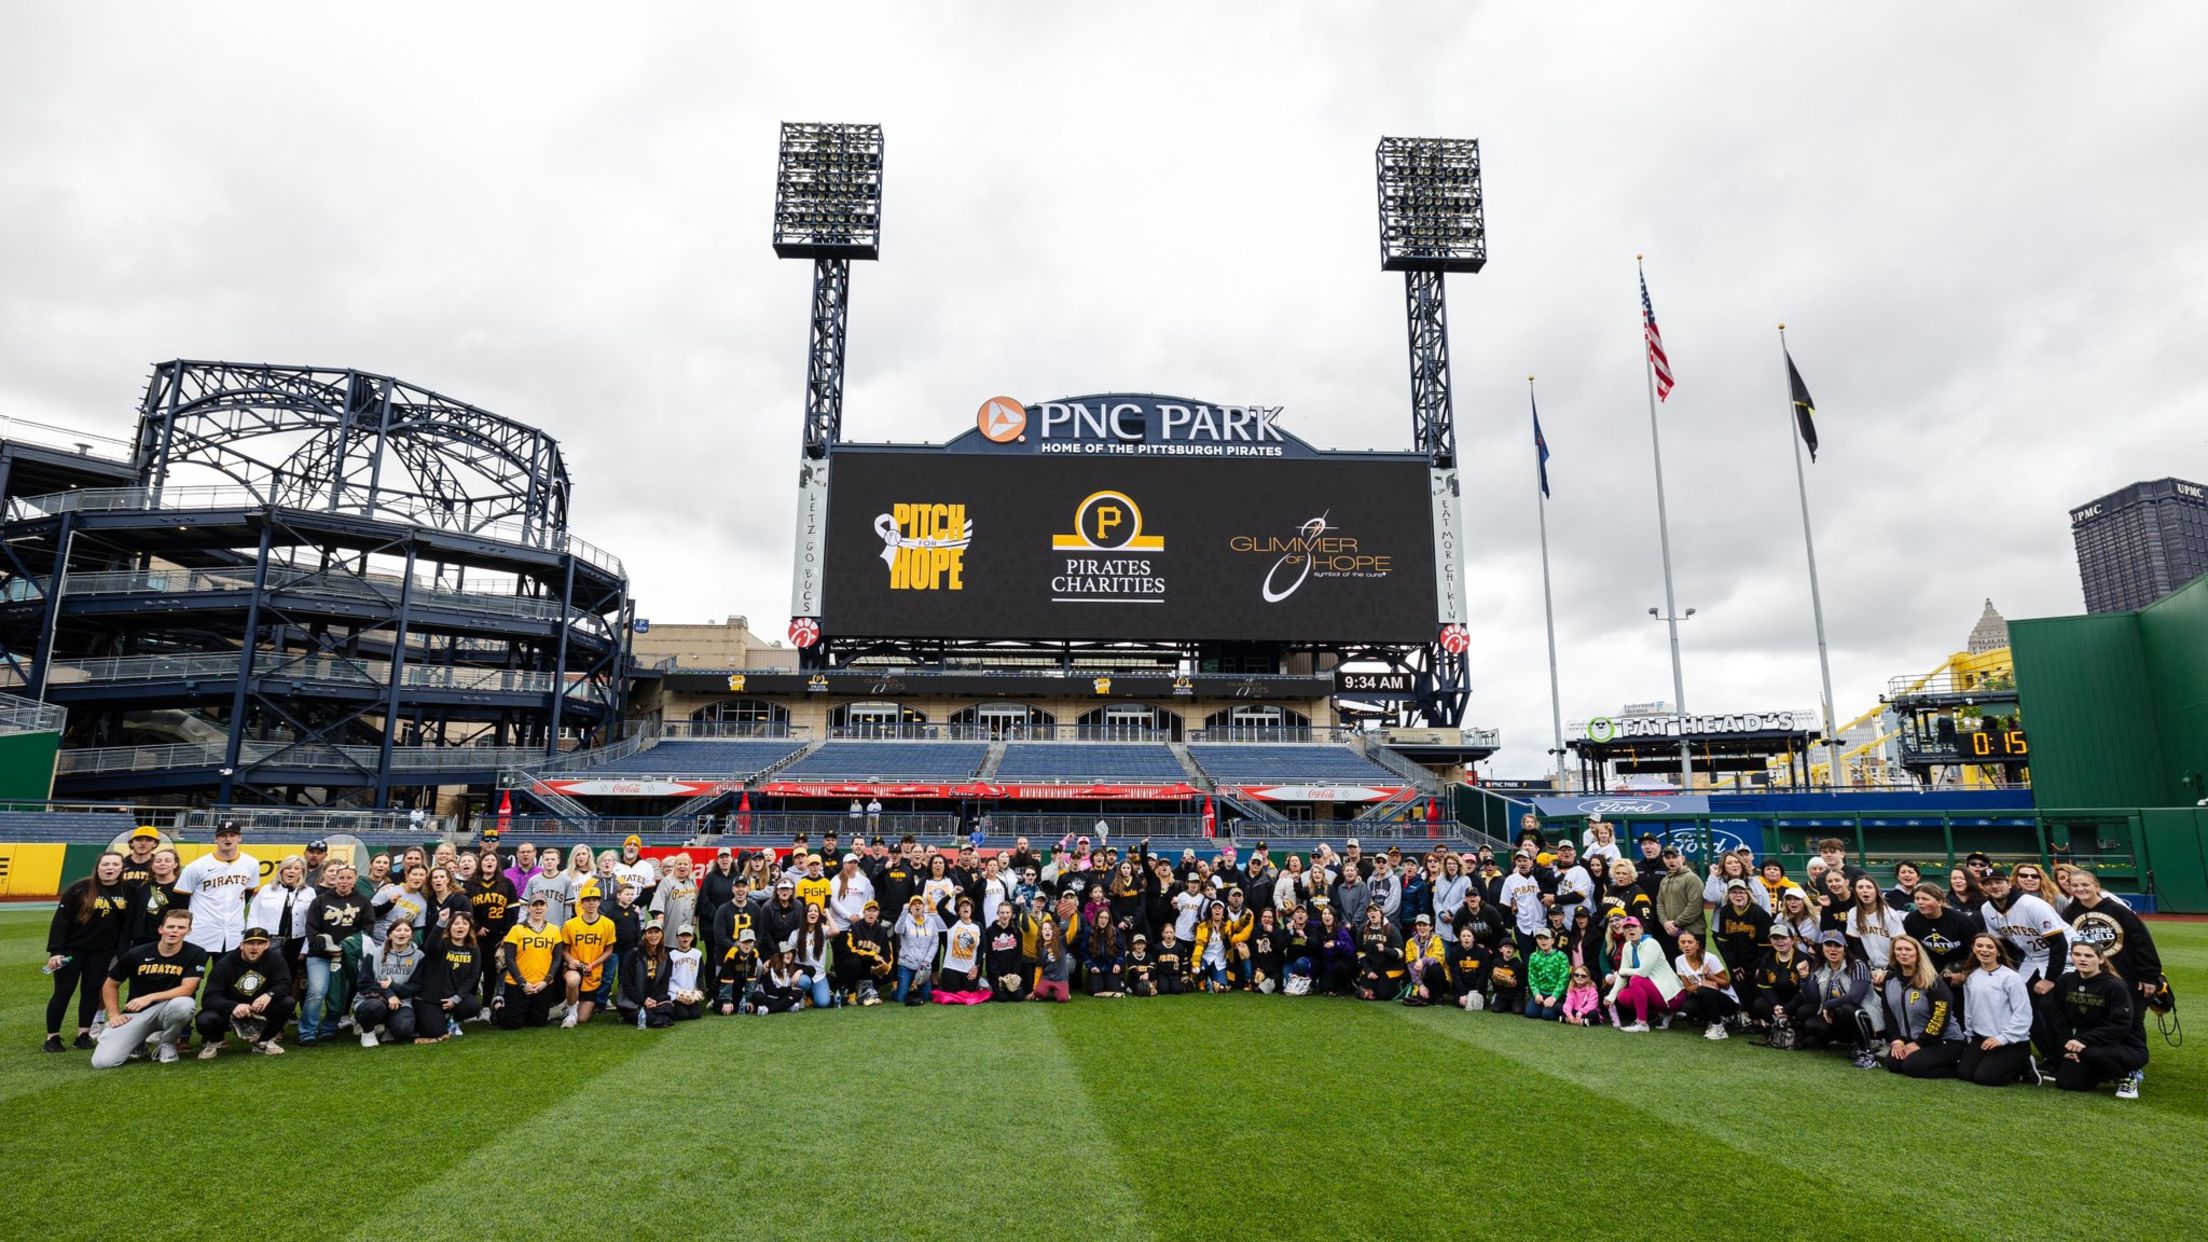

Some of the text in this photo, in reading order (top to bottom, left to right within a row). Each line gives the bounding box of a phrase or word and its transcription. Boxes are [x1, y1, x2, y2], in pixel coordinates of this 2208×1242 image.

[1036, 402, 1285, 442] PNC PARK
[1041, 443, 1282, 456] HOME OF THE PITTSBURGH PIRATES
[2177, 483, 2204, 498] UPMC
[893, 502, 966, 540] PITCH
[2071, 504, 2102, 524] UPMC
[1096, 506, 1122, 539] P
[802, 492, 816, 612] LETZ GO BUCS
[1230, 536, 1358, 552] GLIMMER
[1066, 559, 1151, 576] PIRATES
[1286, 556, 1306, 564] OF
[1312, 556, 1393, 572] HOPE
[1441, 500, 1456, 620] EAT MOR CHIKIN
[890, 547, 964, 590] HOPE
[1051, 576, 1166, 594] CHARITIES
[1344, 676, 1404, 690] 9:34 AM
[1621, 710, 1796, 738] FAT HEAD'S
[1973, 731, 2028, 755] 0:15
[1593, 800, 1652, 813] Ford
[1986, 868, 1994, 877] P
[804, 888, 826, 896] PGH
[488, 907, 504, 919] 22
[732, 913, 752, 940] P
[522, 937, 554, 951] PGH
[575, 932, 602, 946] PGH
[138, 964, 184, 976] PIRATES
[380, 968, 411, 976] PIRATES
[1910, 991, 1920, 1006] P
